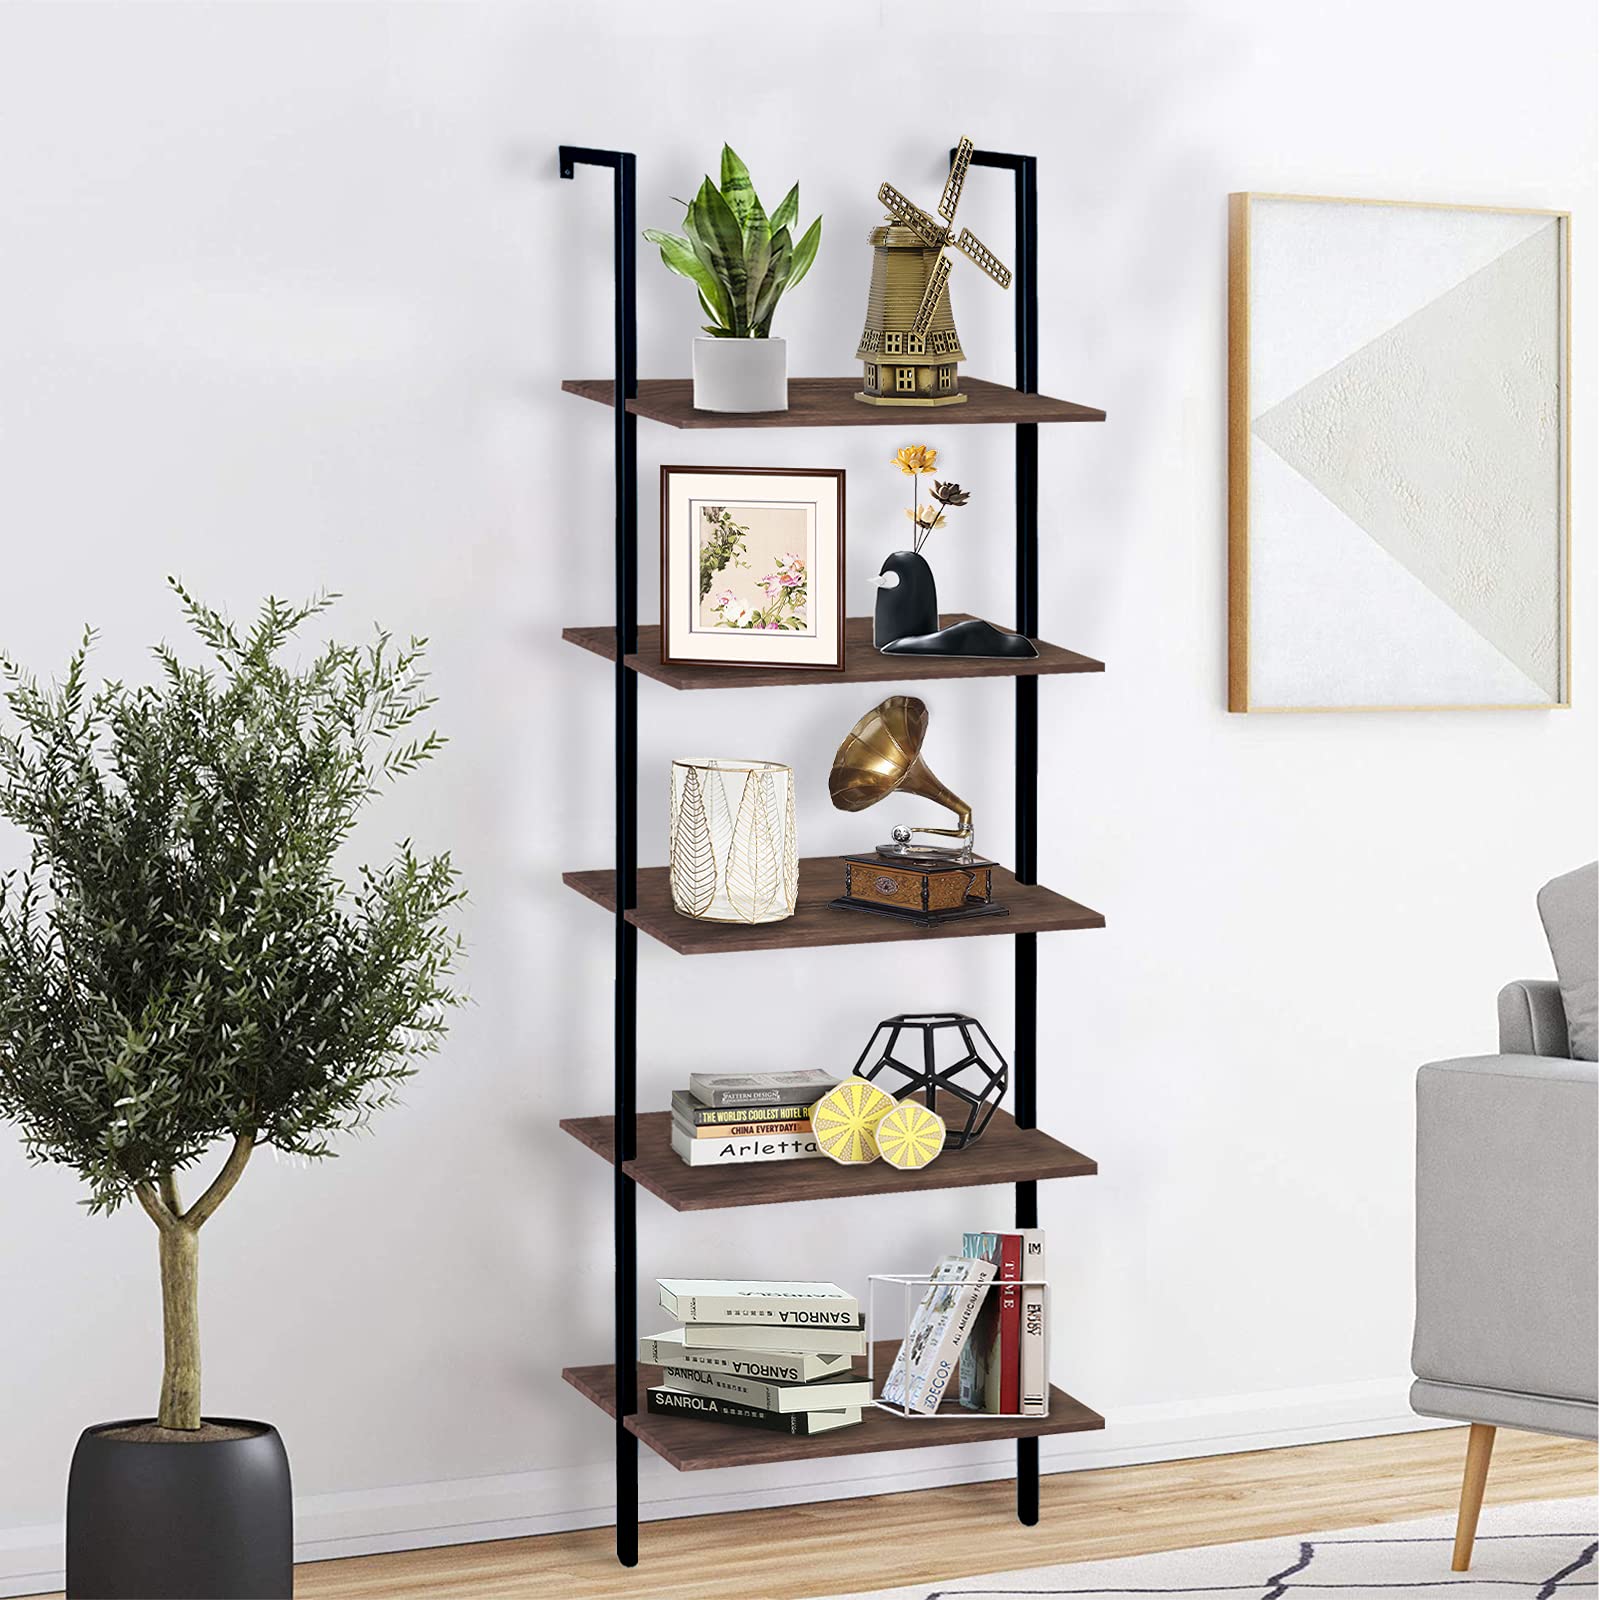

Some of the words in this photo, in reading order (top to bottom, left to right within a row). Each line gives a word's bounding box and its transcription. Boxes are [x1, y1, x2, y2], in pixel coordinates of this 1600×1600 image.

[702, 1112, 716, 1123] THE
[717, 1109, 747, 1122] WORLD'S
[748, 1108, 779, 1120] COOLEST
[780, 1106, 802, 1119] HOTEL
[731, 1126, 754, 1135] CHINA
[719, 1140, 818, 1157] Arletta
[1003, 1260, 1015, 1309] TIME
[778, 1311, 851, 1324] SANROLA
[667, 1366, 713, 1385] SANROLA
[732, 1361, 798, 1380] SANROLA
[925, 1360, 952, 1404] DECOR
[655, 1393, 718, 1413] SANROLA
